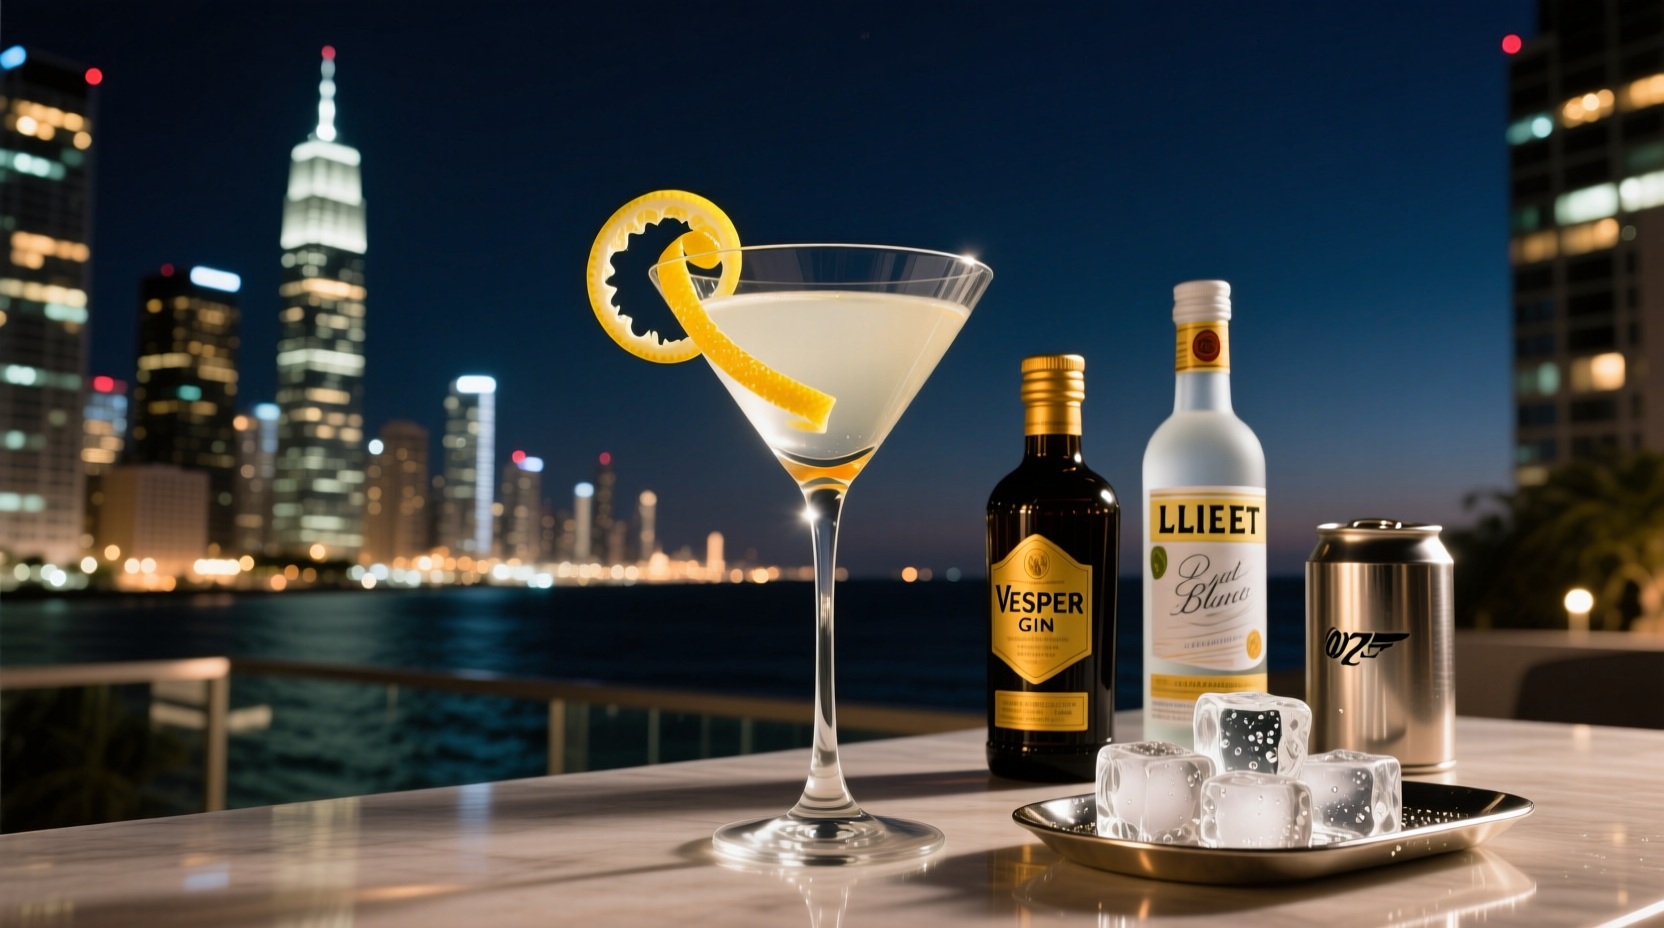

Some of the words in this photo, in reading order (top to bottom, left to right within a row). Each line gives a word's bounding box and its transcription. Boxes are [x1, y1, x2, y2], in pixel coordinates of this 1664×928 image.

[1159, 505, 1260, 534] LLIEET
[996, 585, 1084, 614] VESPER
[1018, 617, 1054, 633] GIN
